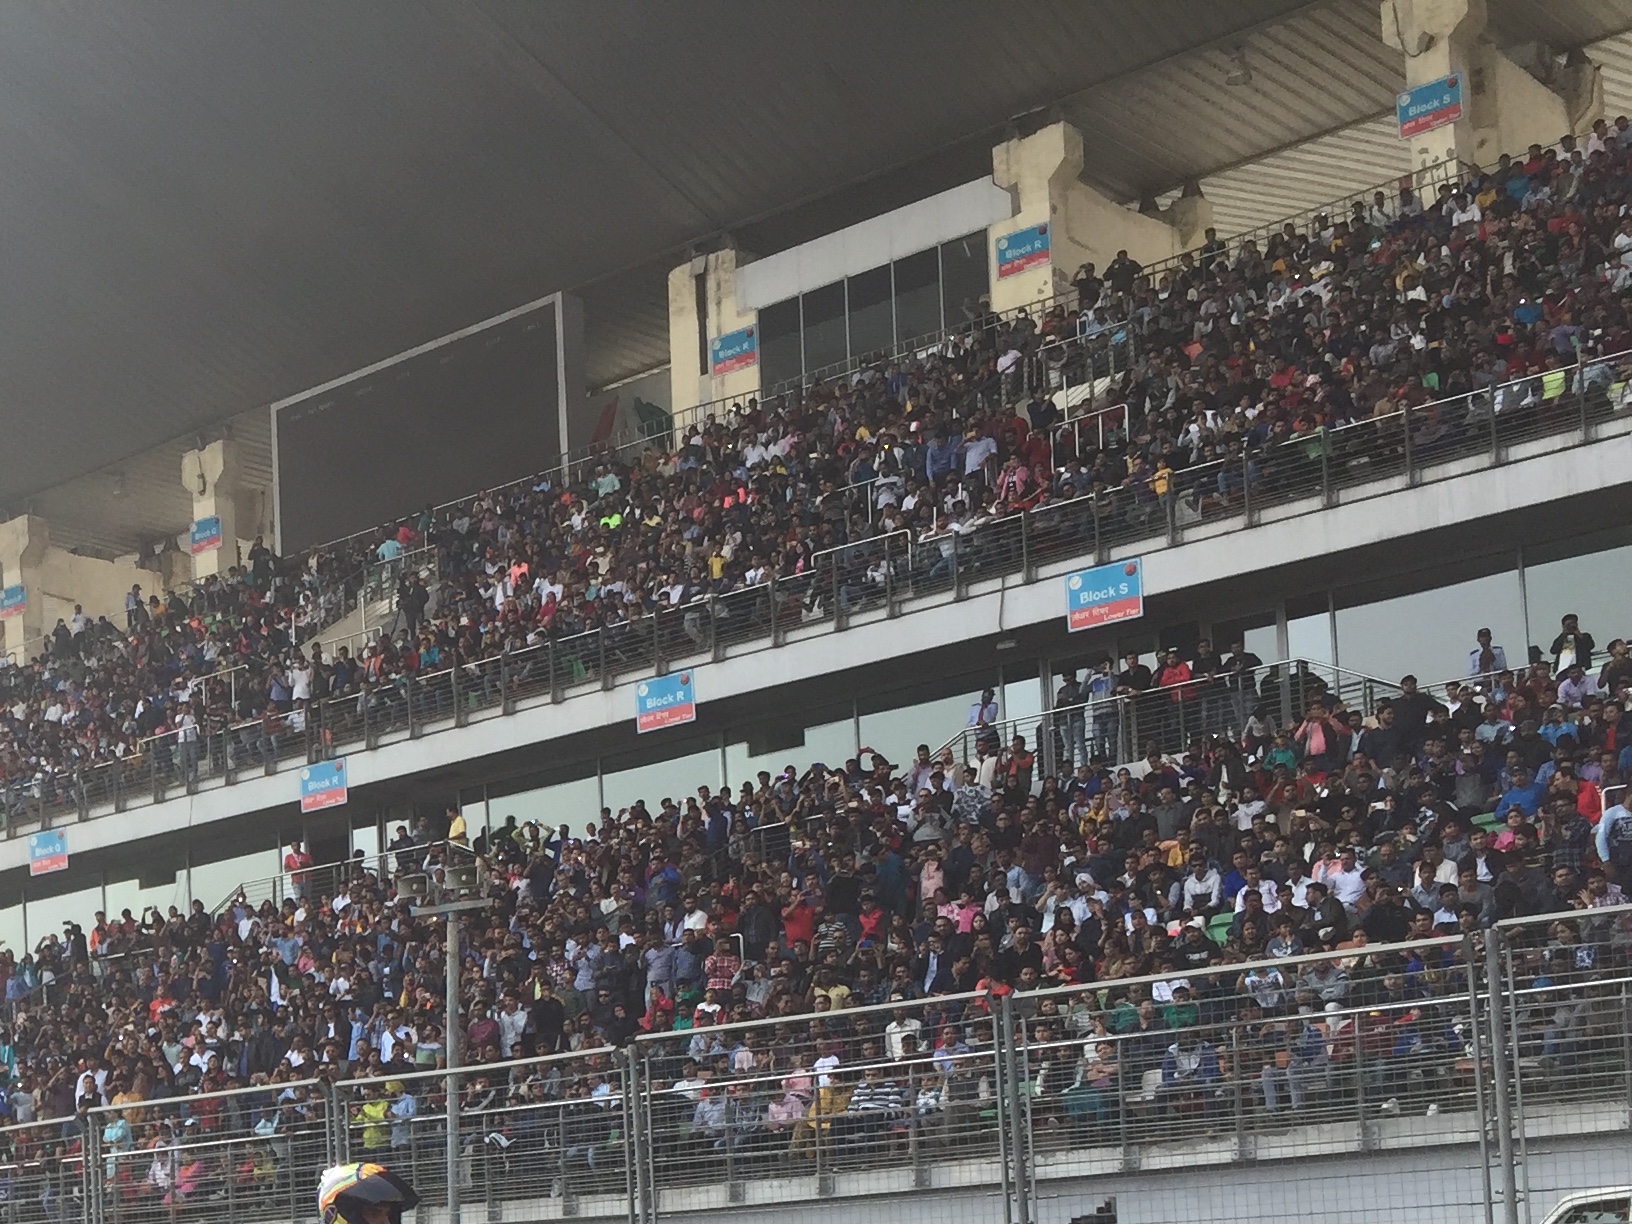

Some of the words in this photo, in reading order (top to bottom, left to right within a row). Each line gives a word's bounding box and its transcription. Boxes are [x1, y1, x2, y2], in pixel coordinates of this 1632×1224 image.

[1408, 99, 1440, 117] Block
[1443, 93, 1451, 104] S
[1005, 244, 1032, 259] Block
[1034, 239, 1042, 249] R
[1079, 585, 1116, 604] Block
[1119, 582, 1129, 595] S
[646, 694, 674, 709] Block
[676, 690, 685, 702] R
[307, 778, 331, 792] Block
[332, 775, 339, 786] R
[35, 846, 54, 857] Block
